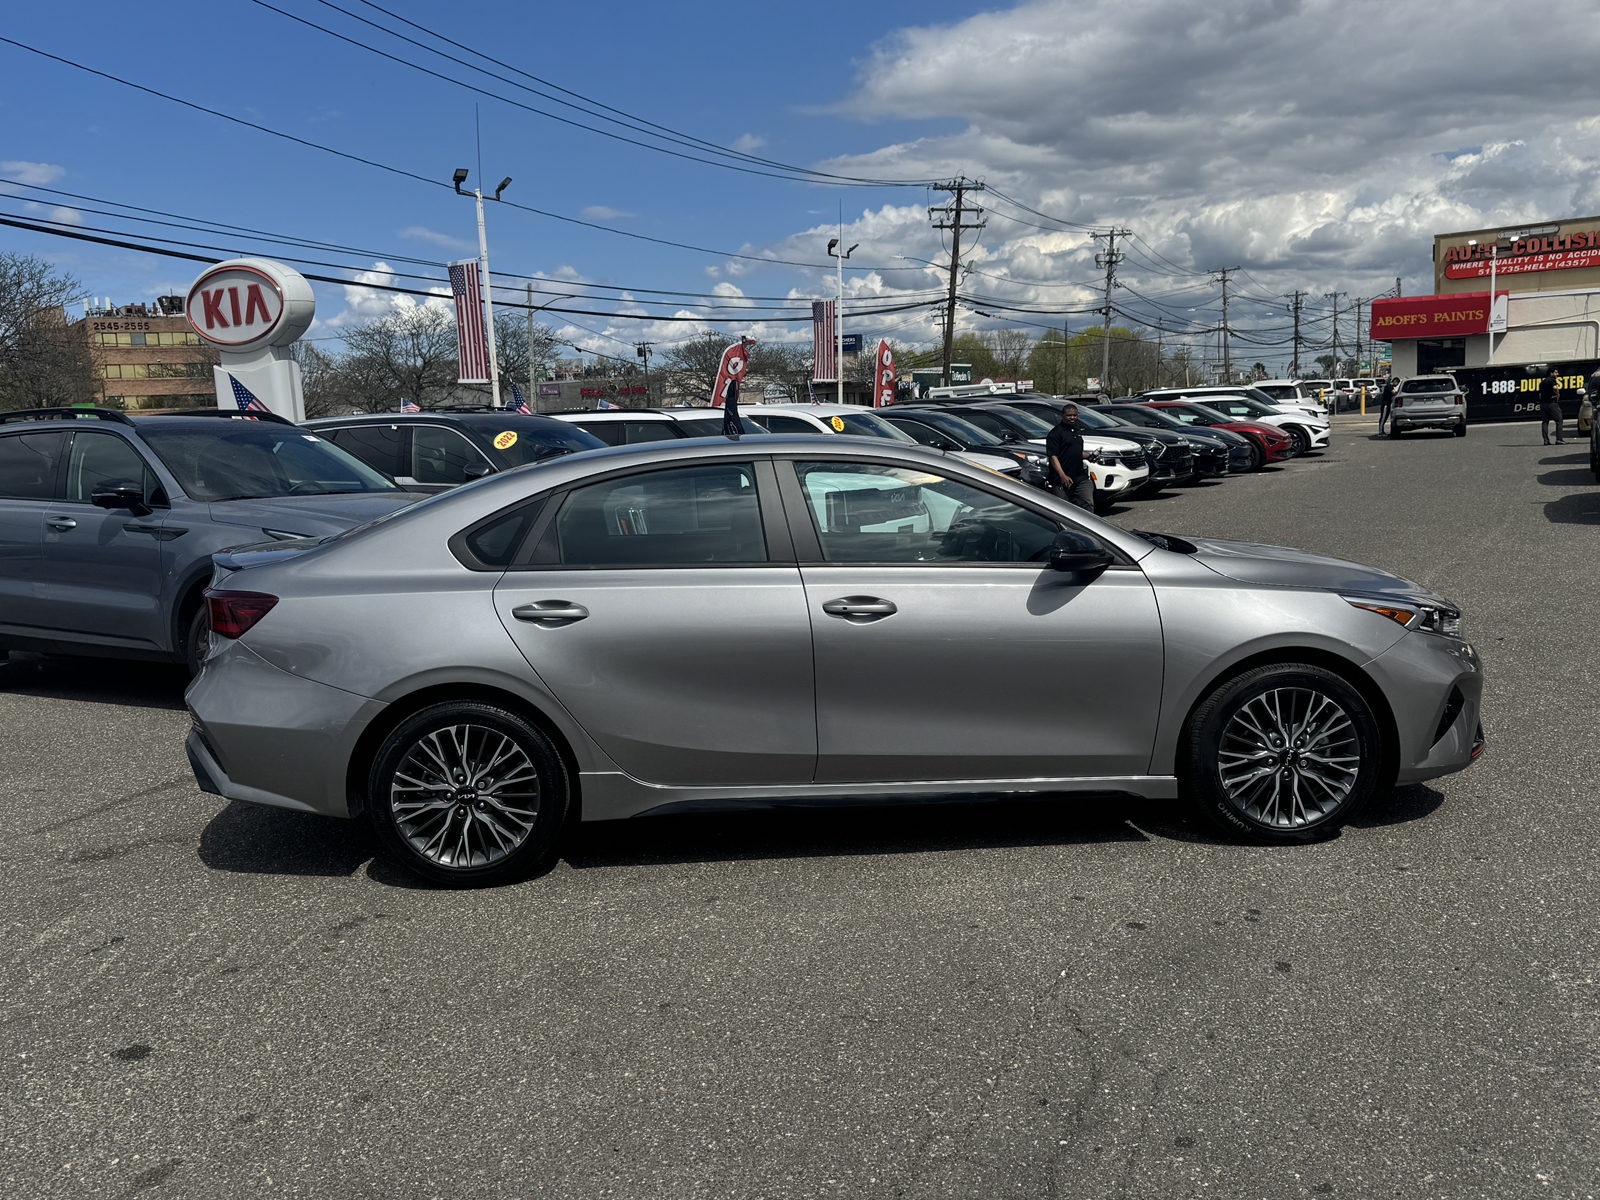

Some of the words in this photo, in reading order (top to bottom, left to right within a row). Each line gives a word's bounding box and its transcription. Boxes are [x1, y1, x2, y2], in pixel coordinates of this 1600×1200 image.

[1512, 230, 1600, 255] COLLISI
[1452, 261, 1485, 270] WHERE
[1533, 254, 1544, 262] IS
[1548, 252, 1563, 261] NO
[1477, 262, 1554, 276] 51-735-HELP
[1555, 257, 1590, 269] (4357)
[201, 284, 272, 329] KIA
[93, 322, 150, 331] 2545-2555
[1377, 313, 1428, 326] ABOFF'S
[1434, 310, 1484, 323] PAINTS
[497, 432, 515, 447] 2022
[1218, 802, 1252, 832] KUMHO
